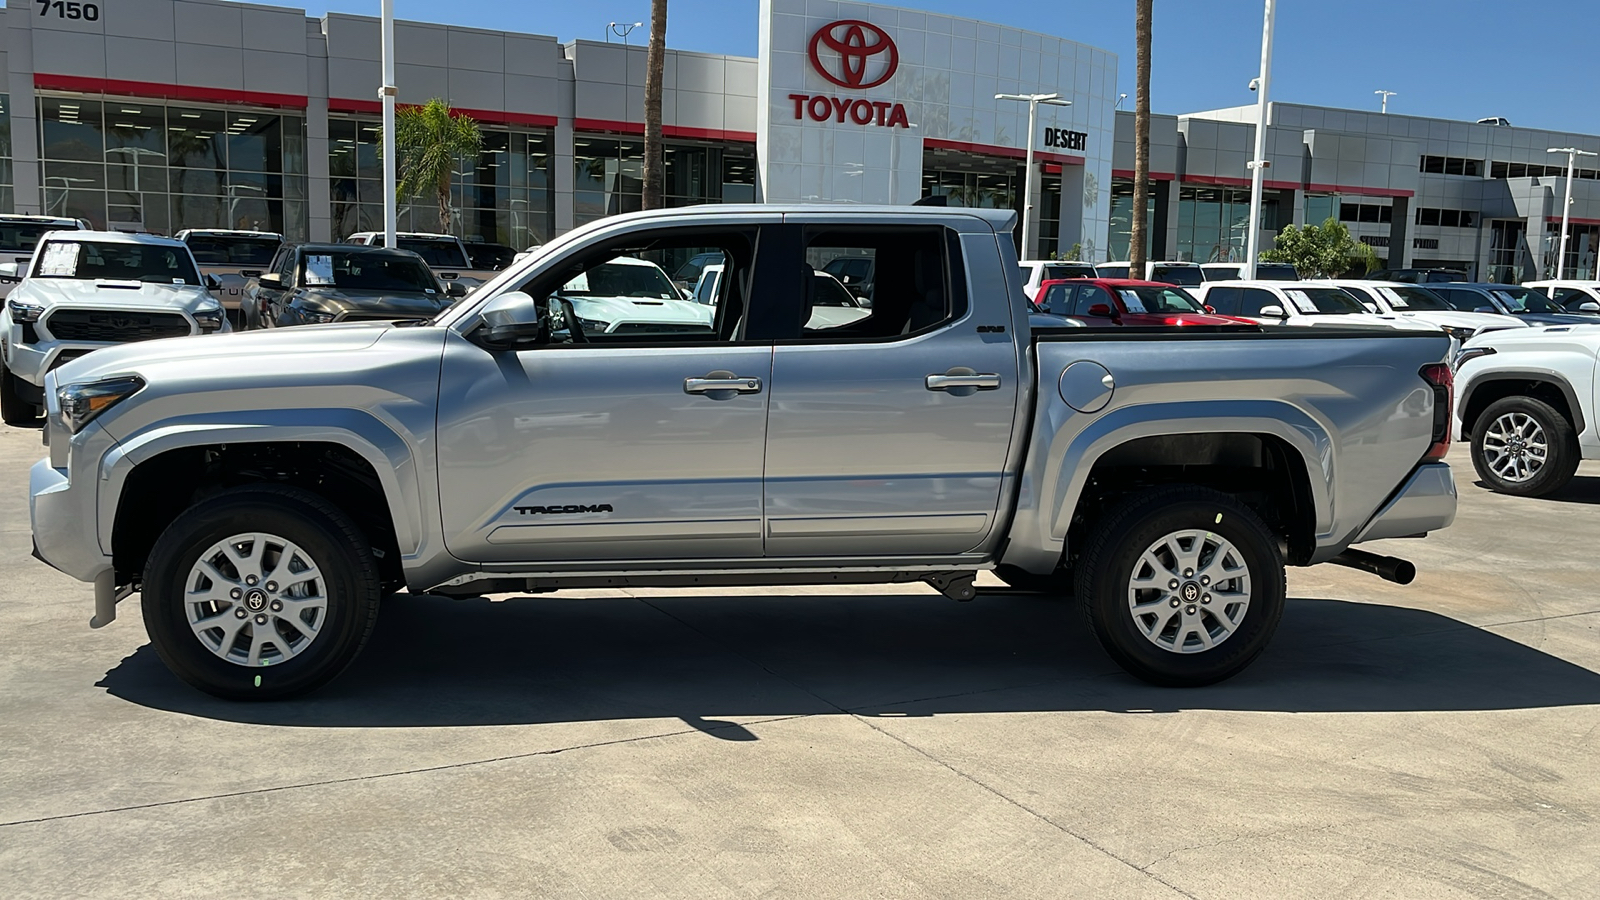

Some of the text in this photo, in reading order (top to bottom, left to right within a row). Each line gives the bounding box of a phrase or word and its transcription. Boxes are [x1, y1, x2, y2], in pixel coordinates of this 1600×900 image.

[36, 0, 99, 21] 7150
[788, 94, 910, 128] TOYOTA
[1045, 127, 1088, 151] DESERT
[513, 504, 613, 515] TACOMA
